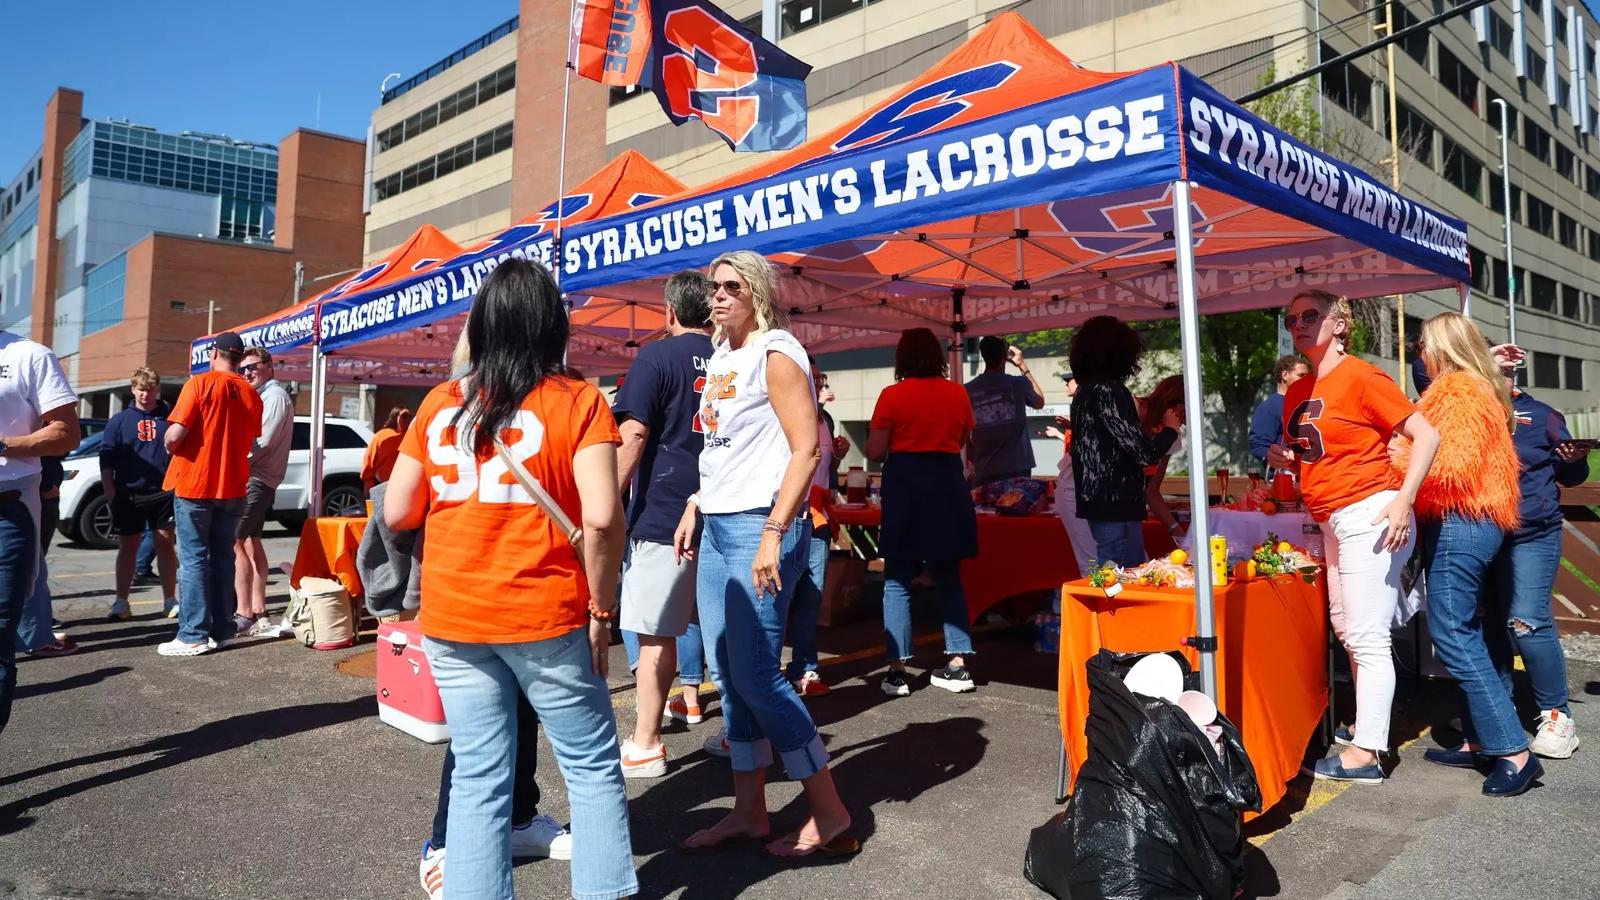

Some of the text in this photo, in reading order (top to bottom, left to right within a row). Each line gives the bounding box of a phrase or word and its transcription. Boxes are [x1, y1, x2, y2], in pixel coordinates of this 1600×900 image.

[564, 94, 1166, 274] SYRACUSE MEN'S LACROSSE
[1188, 96, 1470, 265] SYRACUSE MEN'S LACROSSE
[321, 296, 395, 340] SYRACUSE
[398, 276, 448, 317] MEN'S
[137, 419, 157, 442] S
[426, 406, 545, 504] 92
[1286, 397, 1326, 465] S
